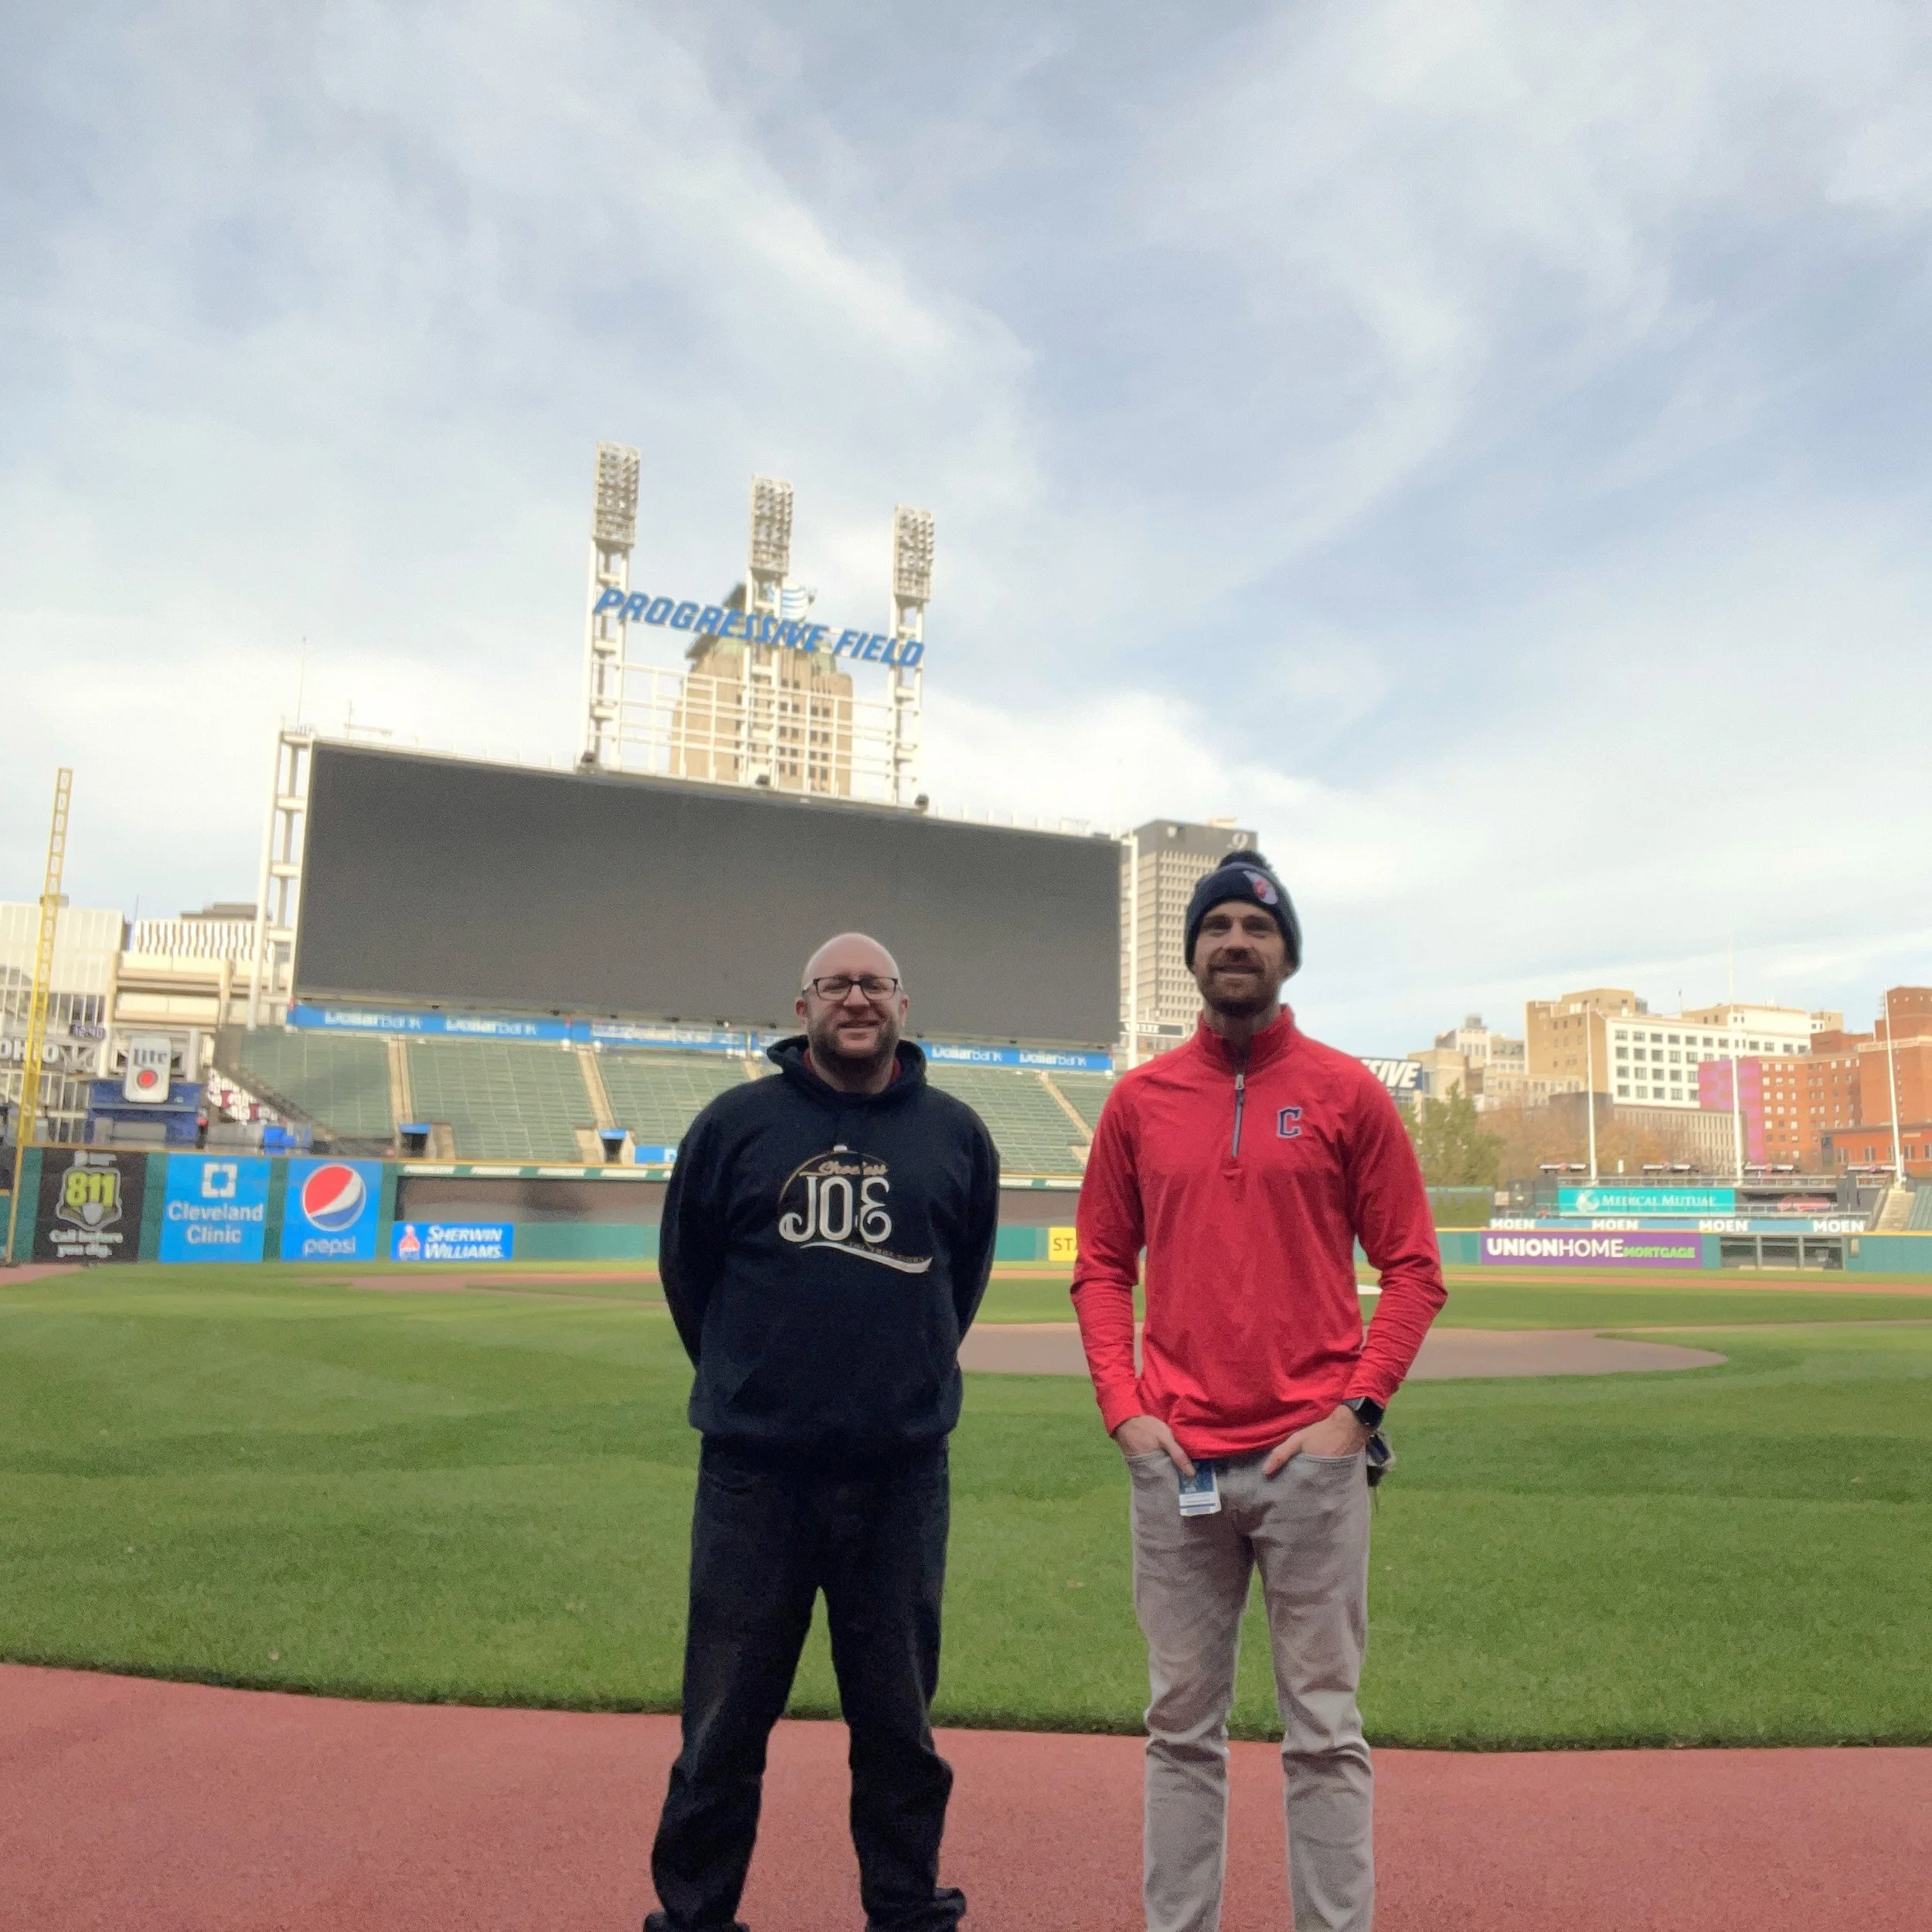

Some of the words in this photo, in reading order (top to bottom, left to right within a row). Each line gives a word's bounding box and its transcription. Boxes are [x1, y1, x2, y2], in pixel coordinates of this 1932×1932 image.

[593, 587, 830, 653] PROGRESSIVE
[832, 628, 925, 668] FIELD
[1277, 1107, 1303, 1138] C
[66, 1169, 116, 1208] 811
[168, 1199, 264, 1222] Cleveland
[778, 1176, 893, 1243] JOE
[1602, 1194, 1658, 1206] MEDICAL
[1662, 1194, 1716, 1207] MUTUAL
[187, 1223, 241, 1244] Clinic
[1489, 1218, 1536, 1230] MOEN
[1591, 1219, 1639, 1231] MOEN
[1699, 1219, 1749, 1233] MOEN
[1812, 1219, 1866, 1233] MOEN
[303, 1236, 356, 1257] pepsi
[1053, 1237, 1078, 1251] ST
